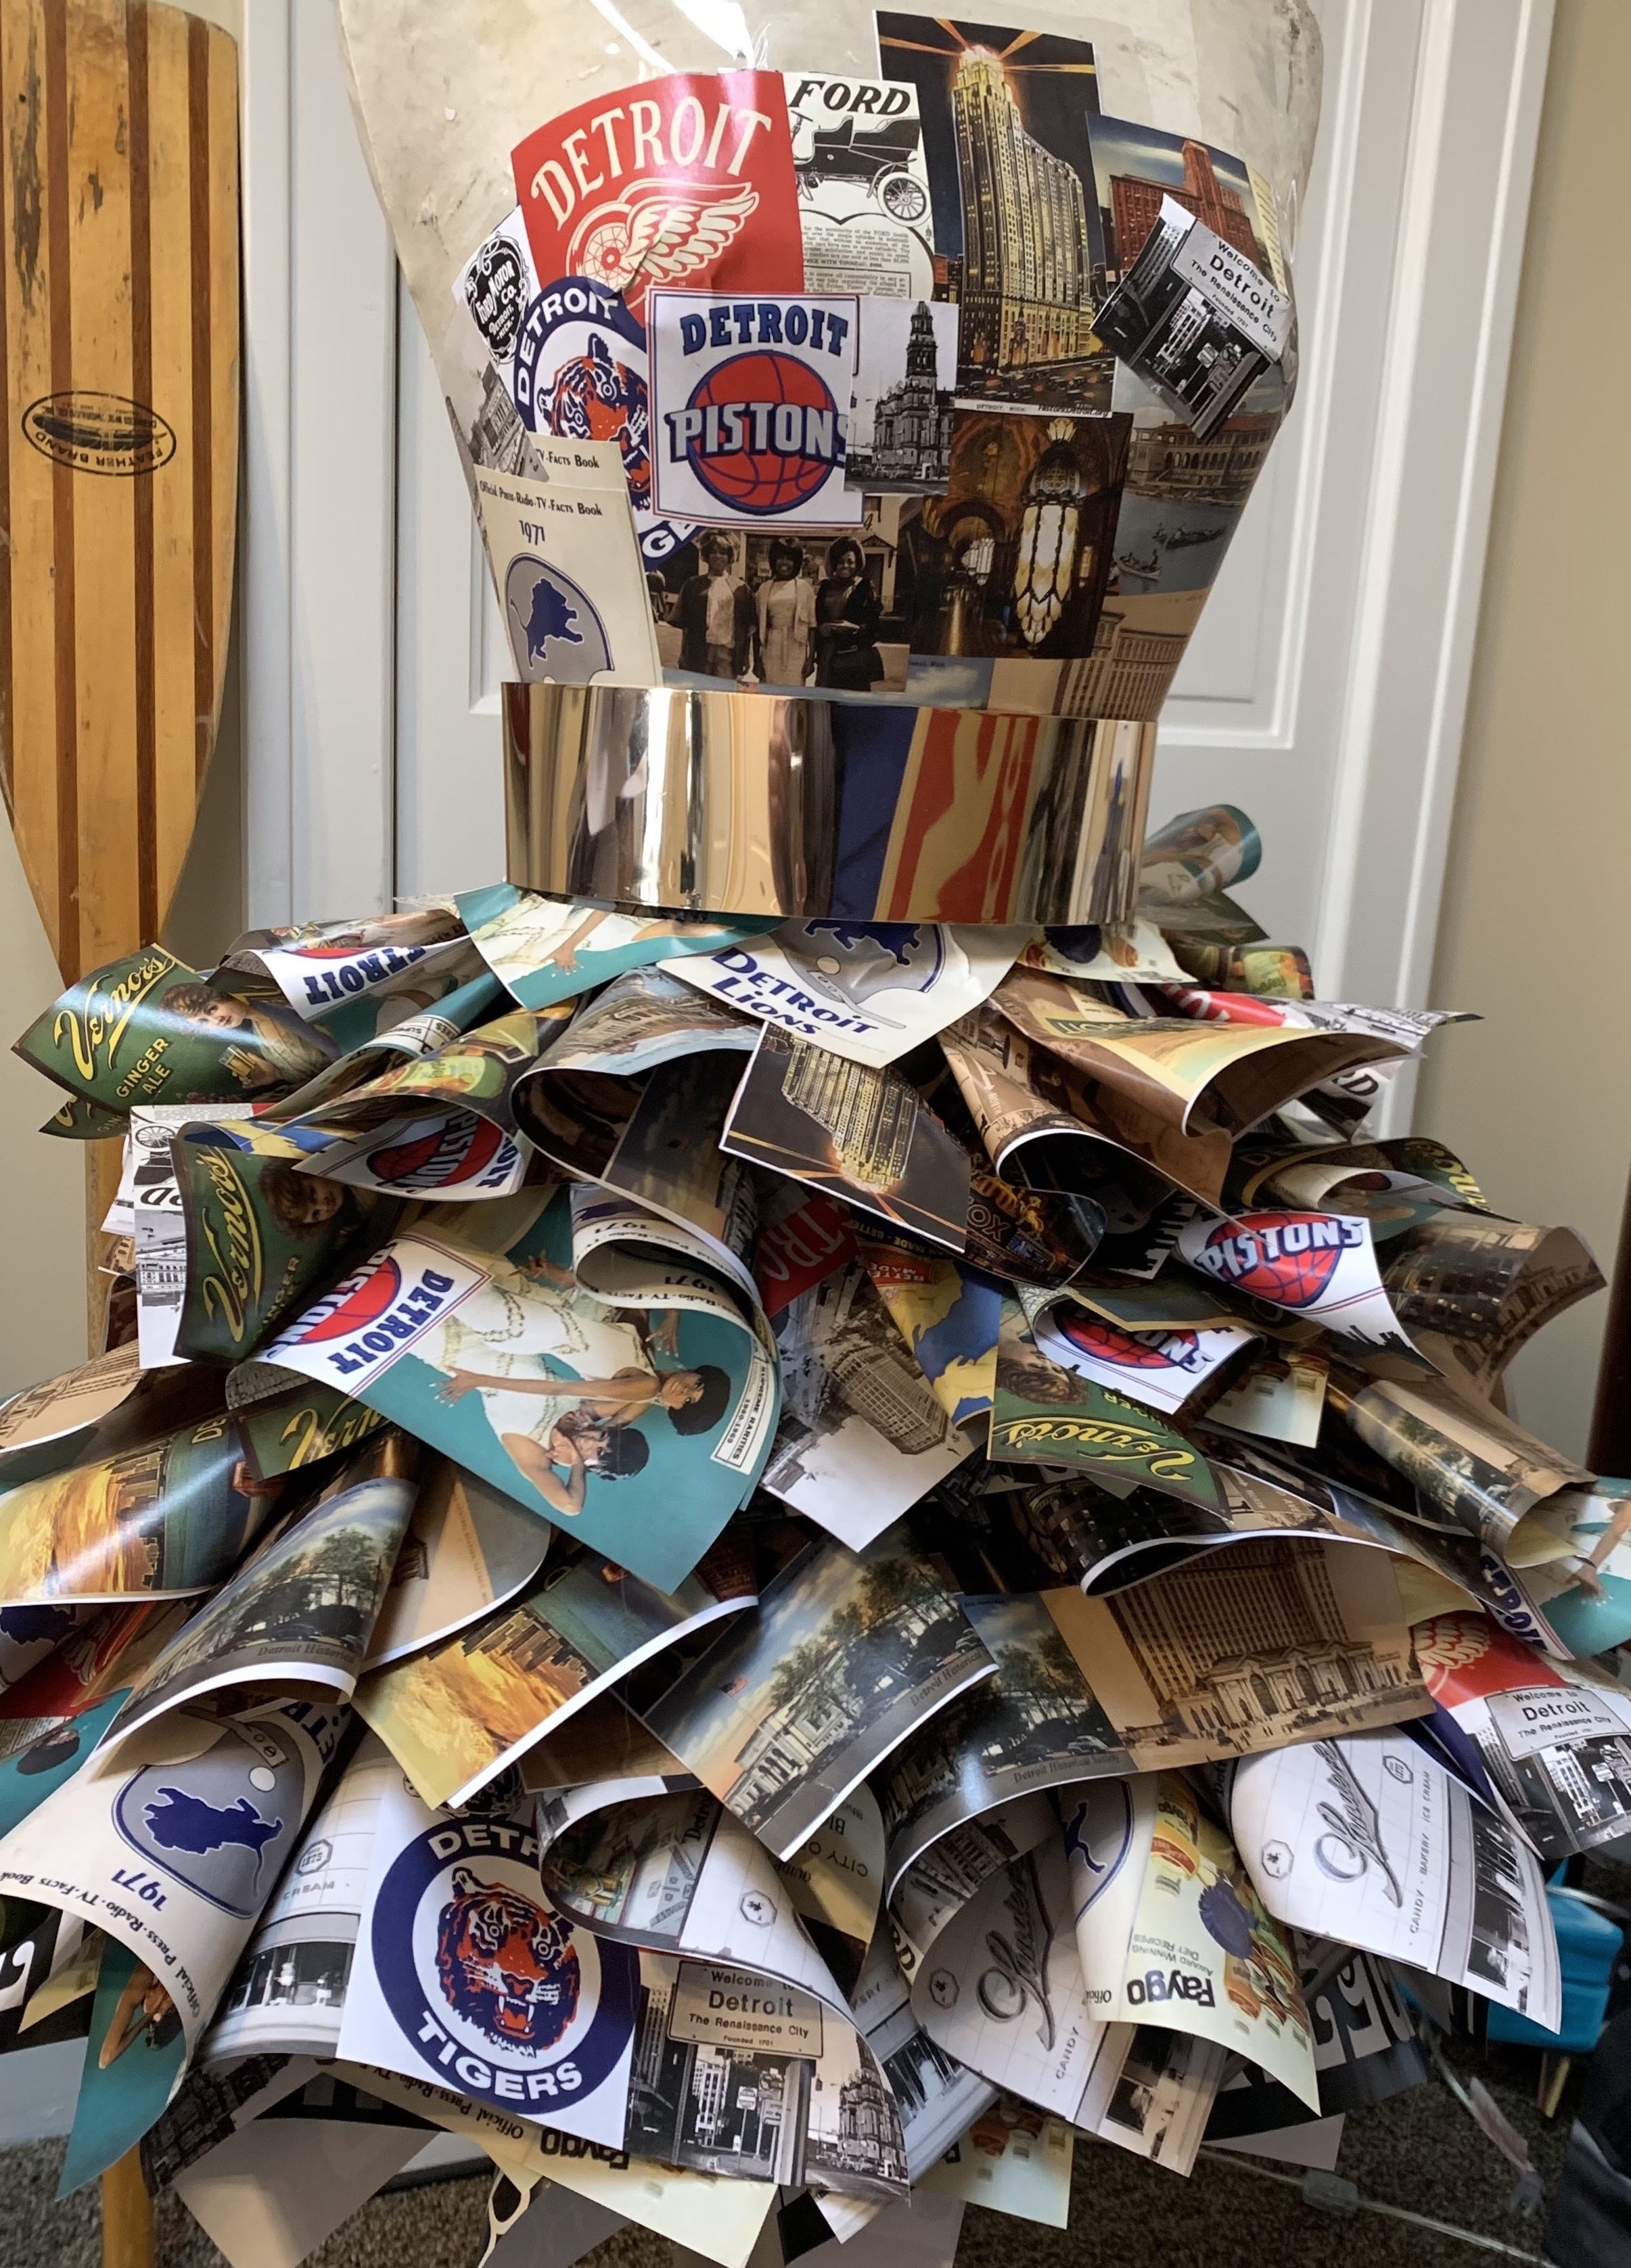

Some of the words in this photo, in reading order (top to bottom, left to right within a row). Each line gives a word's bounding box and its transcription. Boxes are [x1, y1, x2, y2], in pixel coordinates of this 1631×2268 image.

[788, 79, 910, 116] FORD
[530, 96, 772, 231] DETROIT
[488, 260, 515, 316] MOTOR
[1209, 254, 1275, 319] Detroit
[1218, 240, 1264, 287] Welcome
[1269, 288, 1281, 303] to
[1191, 258, 1208, 277] The
[1210, 276, 1260, 324] Renaissance
[1262, 323, 1278, 343] City
[516, 287, 621, 406] DETROIT
[679, 303, 849, 356] DETROIT
[35, 431, 89, 464] BRAND
[574, 455, 599, 468] Book
[576, 502, 603, 516] Book
[518, 519, 546, 546] 1971
[710, 946, 879, 1034] DETROIT
[710, 976, 822, 1035] LIONS
[53, 956, 176, 1081] Vernor's
[115, 1037, 170, 1098] GINGER
[141, 1065, 171, 1095] ALE
[1193, 1220, 1364, 1278] PISTONS
[326, 1268, 455, 1375] DETROIT
[732, 1416, 756, 1460] RARITIES
[992, 1415, 1196, 1481] Vernor's
[257, 1644, 302, 1657] Detroit
[910, 1676, 944, 1707] Detroit
[1512, 1691, 1562, 1703] Welcome
[1517, 1728, 1537, 1739] The
[1540, 1716, 1592, 1733] Renaissance
[1594, 1715, 1613, 1725] City
[1521, 1700, 1592, 1722] Detroit
[1013, 1765, 1048, 1783] Detroit
[1423, 1771, 1431, 1806] CREAM
[827, 1850, 869, 1878] CITY
[1419, 1835, 1431, 1876] BAKERY
[0, 1870, 35, 1886] Book
[110, 1868, 168, 1912] 1971
[283, 1880, 336, 1901] CREAM
[76, 1889, 101, 1907] TV
[1409, 1889, 1425, 1935] CANDY
[1132, 1943, 1176, 1963] WINNING
[1180, 1955, 1214, 1977] AWARD
[1134, 1933, 1175, 1953] RECIPES
[1178, 1947, 1199, 1962] DIET
[174, 1965, 201, 2018] Official
[711, 1970, 774, 1988] Welcome
[1126, 1969, 1216, 2008] Faygo
[708, 1990, 794, 2018] Detroit
[689, 2013, 710, 2026] The
[715, 2016, 783, 2035] Renaissance
[788, 2024, 810, 2039] City
[723, 2035, 754, 2045] Founded
[417, 2010, 583, 2100] TIGERS
[1055, 2026, 1081, 2081] CANDY
[476, 2108, 524, 2140] Official
